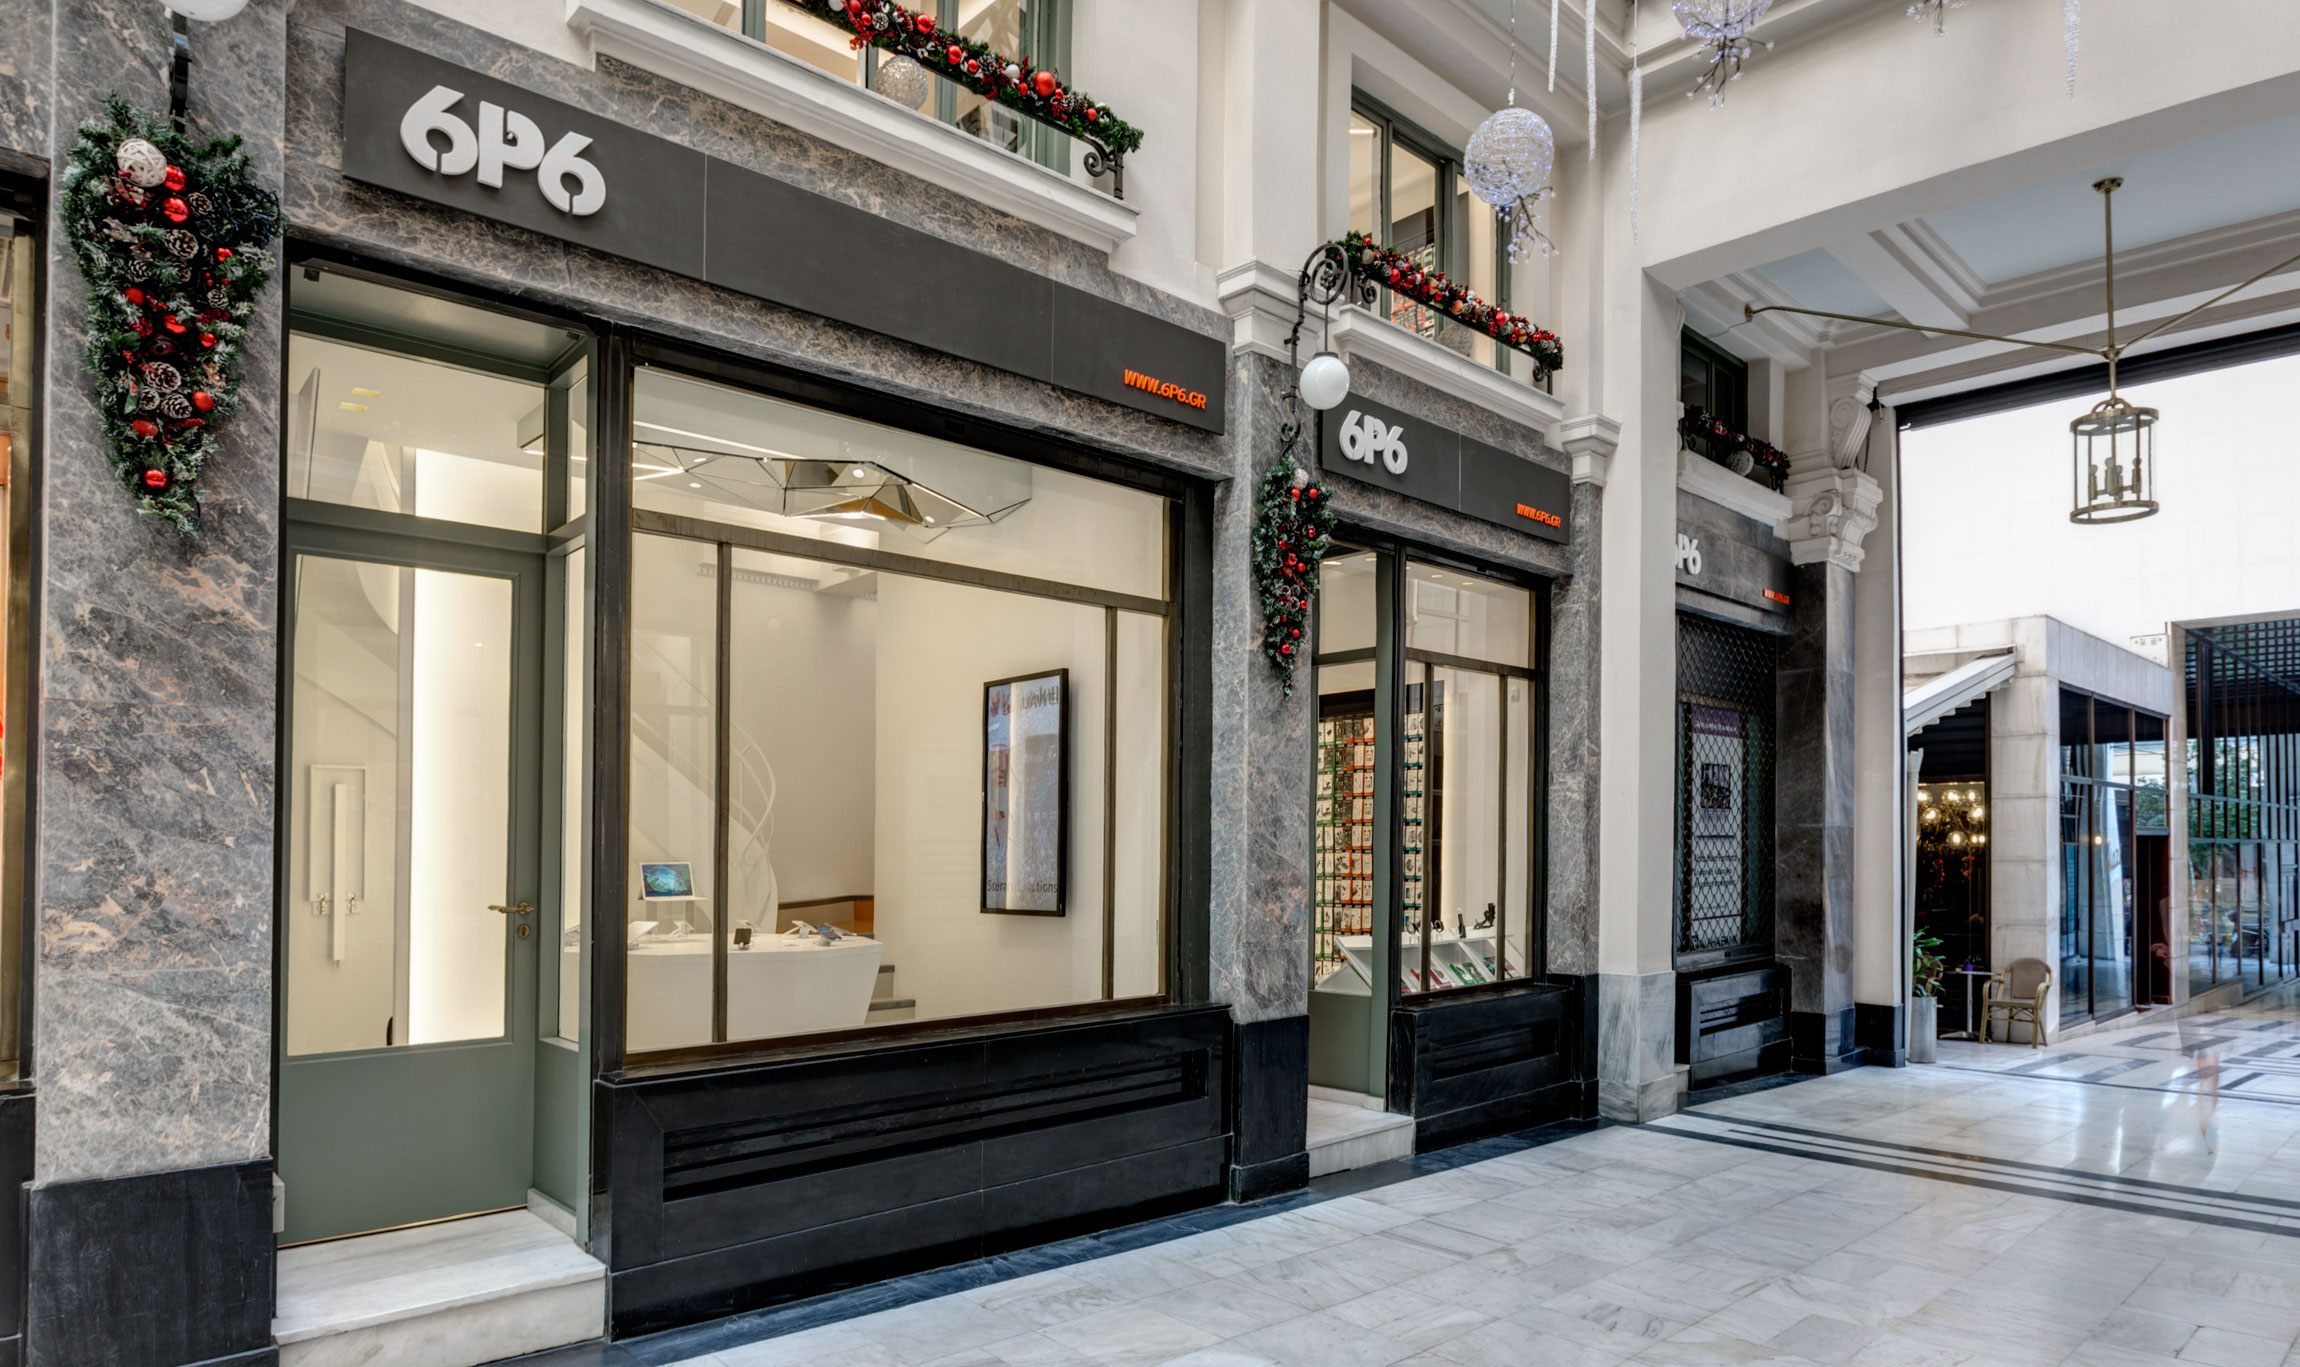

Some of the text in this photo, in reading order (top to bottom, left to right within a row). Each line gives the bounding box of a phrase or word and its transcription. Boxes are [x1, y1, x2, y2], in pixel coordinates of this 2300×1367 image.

[400, 85, 607, 217] 6P6
[1123, 368, 1207, 410] WWW.6P6.GR
[1339, 409, 1408, 475] 6P6
[1675, 533, 1702, 575] P6
